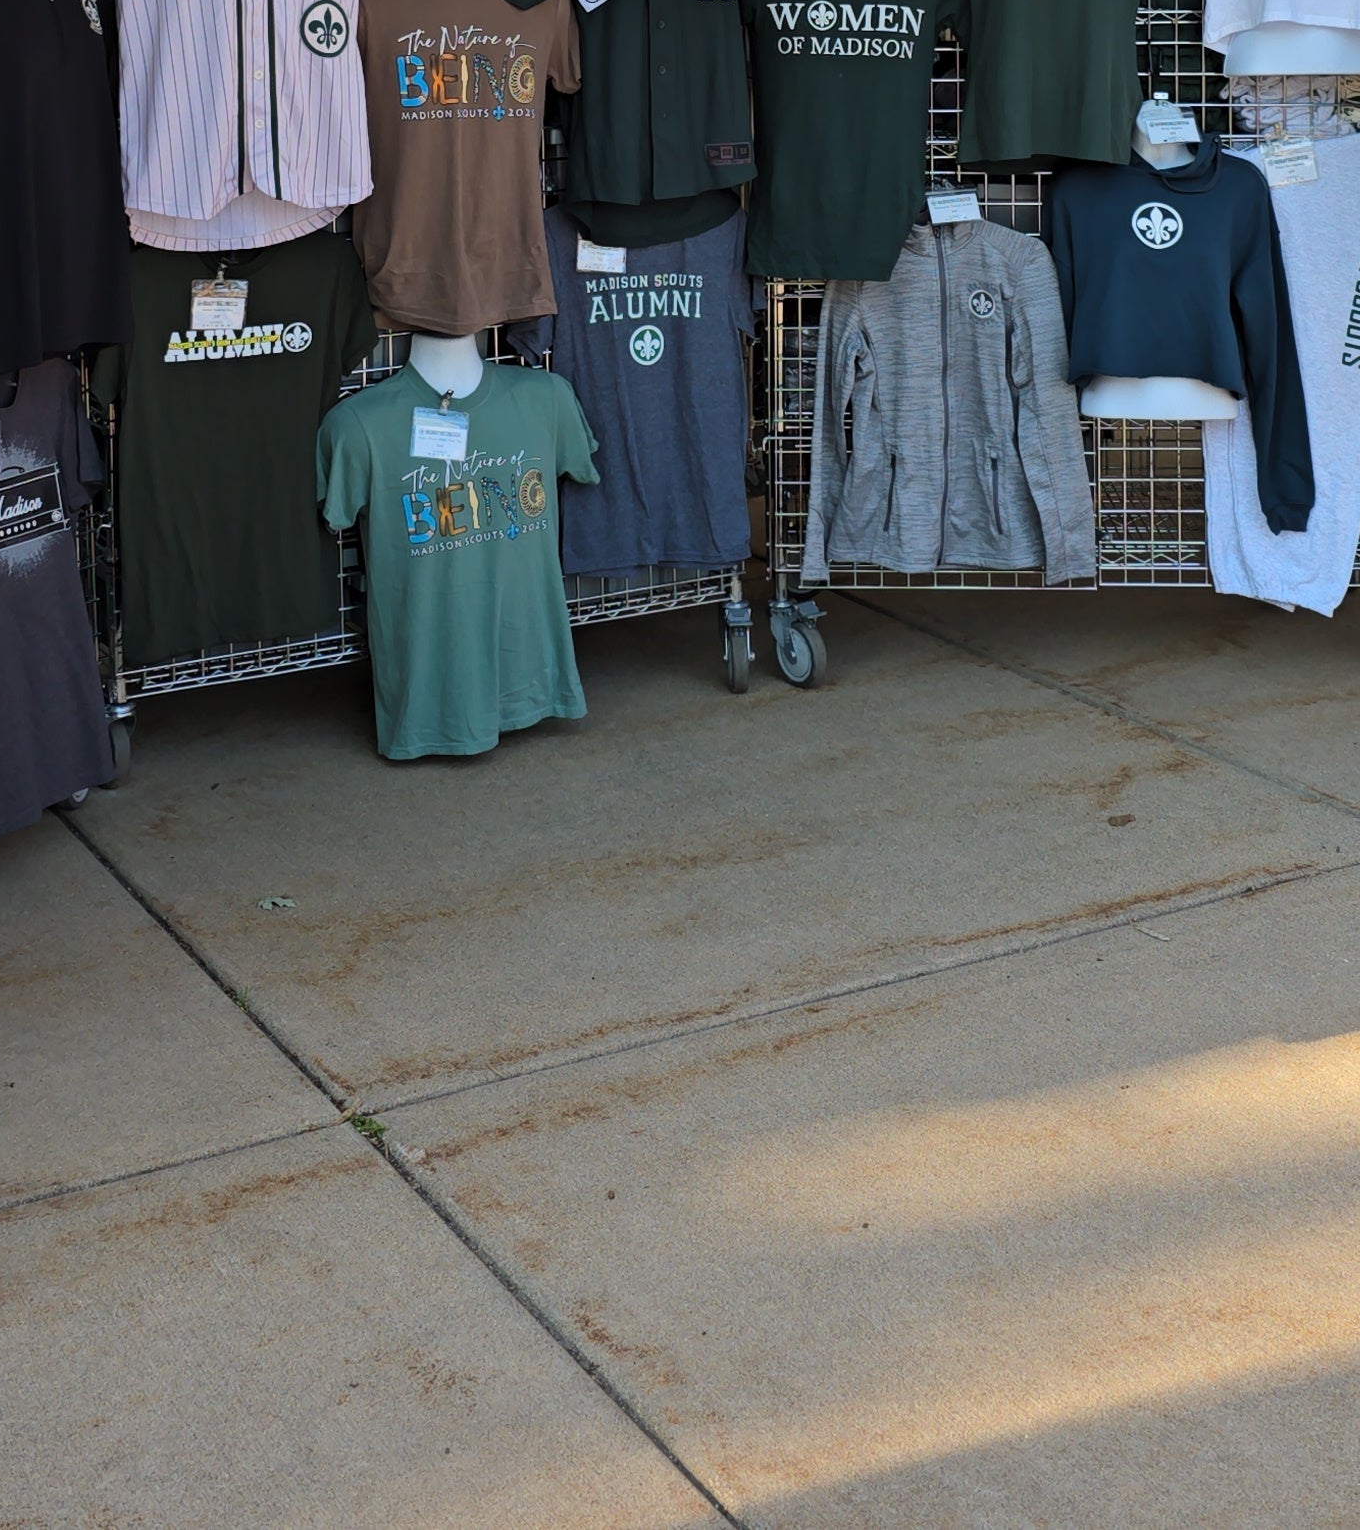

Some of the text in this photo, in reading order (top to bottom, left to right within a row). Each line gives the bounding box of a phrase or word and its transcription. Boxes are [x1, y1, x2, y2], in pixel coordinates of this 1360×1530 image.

[398, 25, 537, 58] The Nature of
[778, 37, 915, 59] OF MADISON
[396, 53, 536, 107] BEING
[401, 108, 536, 120] MADISON 2025
[586, 274, 703, 293] MADISON SCOUTS
[589, 290, 701, 324] ALUMNI
[164, 324, 283, 362] ALUMNI
[401, 450, 541, 493] The Nature of
[401, 469, 546, 543] BEING
[410, 520, 548, 558] MADISON SCOUTS 2025
